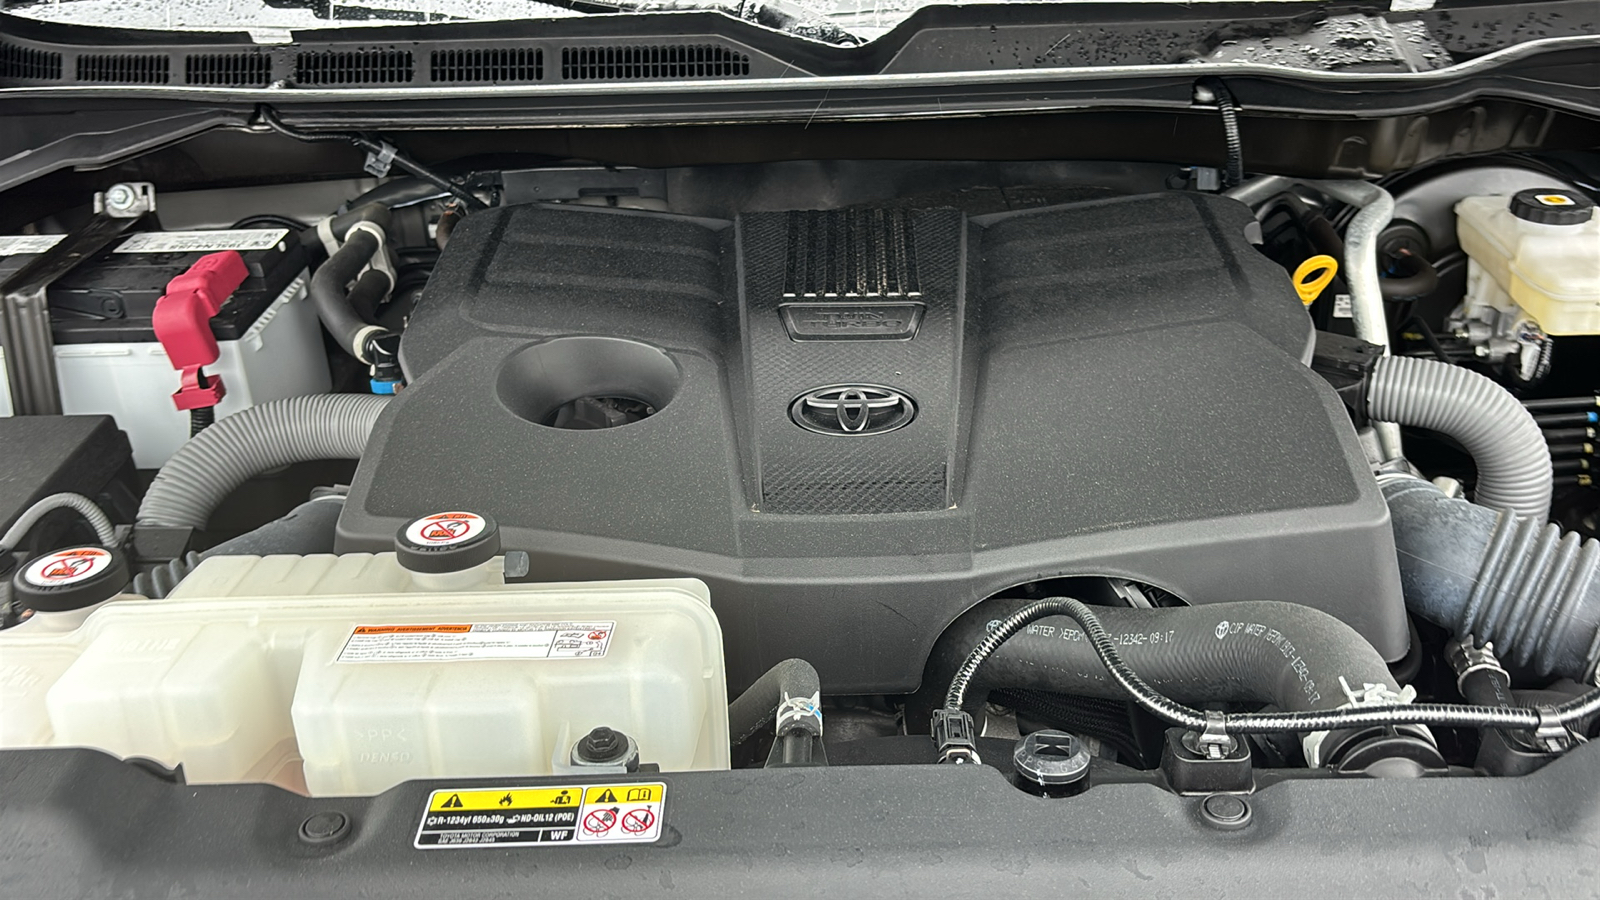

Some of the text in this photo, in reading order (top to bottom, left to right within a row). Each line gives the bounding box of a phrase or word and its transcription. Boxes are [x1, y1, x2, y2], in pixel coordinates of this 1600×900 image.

[803, 320, 902, 328] TURBO
[1026, 624, 1055, 638] WATER
[359, 751, 412, 763] DENSO
[437, 815, 471, 826] R-1234yf
[472, 814, 504, 825] 650±30g
[554, 812, 575, 823] (POE)
[550, 830, 569, 840] WF
